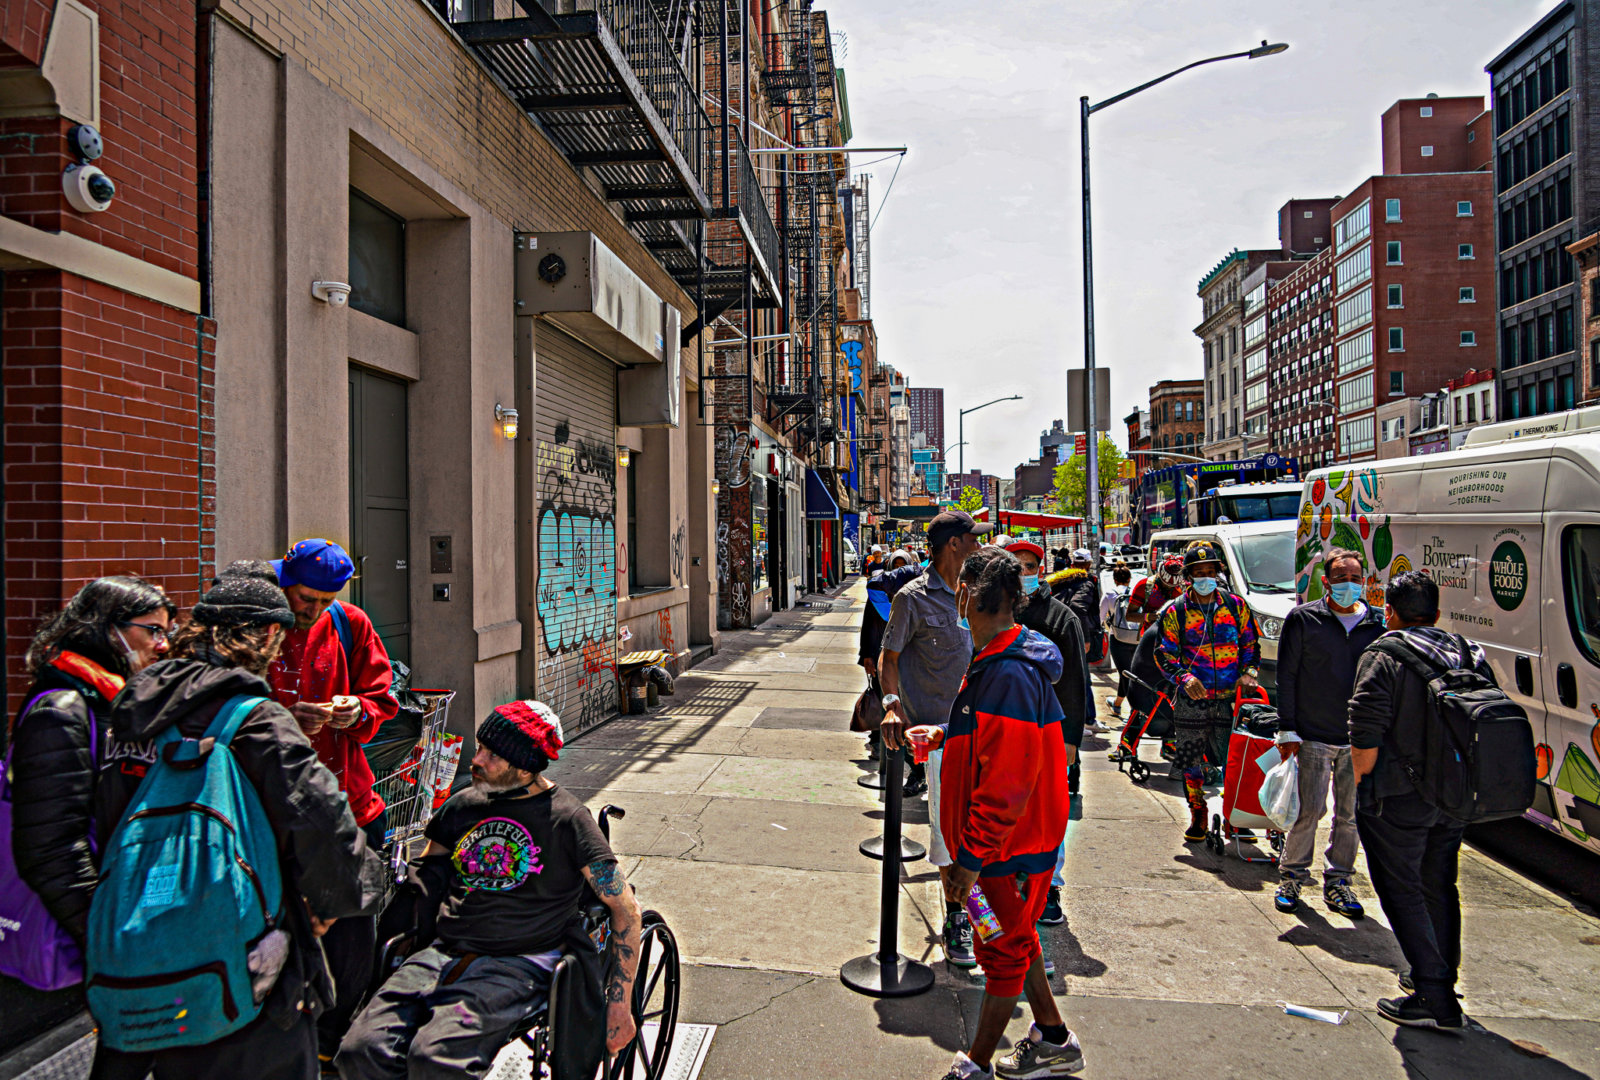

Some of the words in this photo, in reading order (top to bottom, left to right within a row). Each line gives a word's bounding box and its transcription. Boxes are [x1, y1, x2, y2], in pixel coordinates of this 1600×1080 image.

[1522, 426, 1545, 436] THERMO
[1545, 423, 1559, 433] KING
[1201, 462, 1257, 472] NORTHEAST
[1267, 457, 1277, 465] 17
[1449, 471, 1490, 485] NOURISHING
[1492, 470, 1507, 481] OUR
[1448, 483, 1505, 497] NEIGHBORHOODS
[1457, 495, 1492, 505] TOGETHER
[1431, 536, 1445, 547] The
[1493, 528, 1520, 542] SPONSORED
[1422, 544, 1471, 575] Bowery
[1493, 560, 1524, 576] WHOLE
[1431, 569, 1468, 589] Mission
[1494, 574, 1523, 590] FOODS
[1496, 590, 1519, 598] MARKET
[1450, 611, 1493, 627] BOWERY.ORG
[461, 822, 529, 850] GRATEFUL
[144, 875, 177, 895] GOOD
